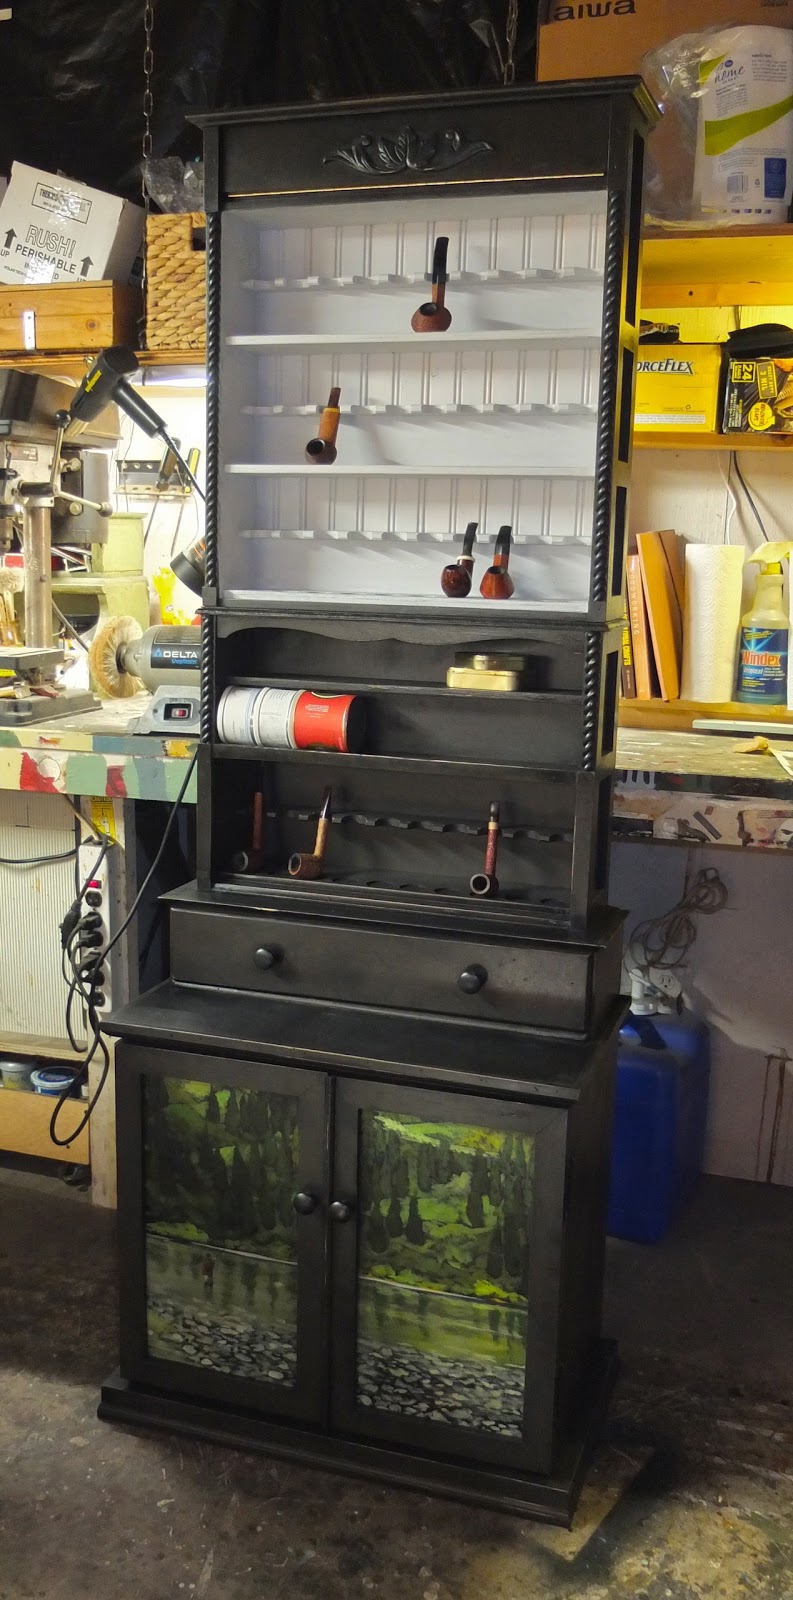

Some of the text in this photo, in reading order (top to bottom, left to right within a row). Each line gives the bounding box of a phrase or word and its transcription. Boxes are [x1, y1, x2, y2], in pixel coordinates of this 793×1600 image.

[553, 0, 637, 20] aiwa
[715, 62, 745, 83] home
[25, 224, 76, 258] RUSH!
[0, 249, 10, 258] UP
[15, 244, 77, 275] PERISHABLE
[742, 364, 753, 380] 24
[163, 650, 198, 658] DELTA
[742, 650, 781, 667] Windex
